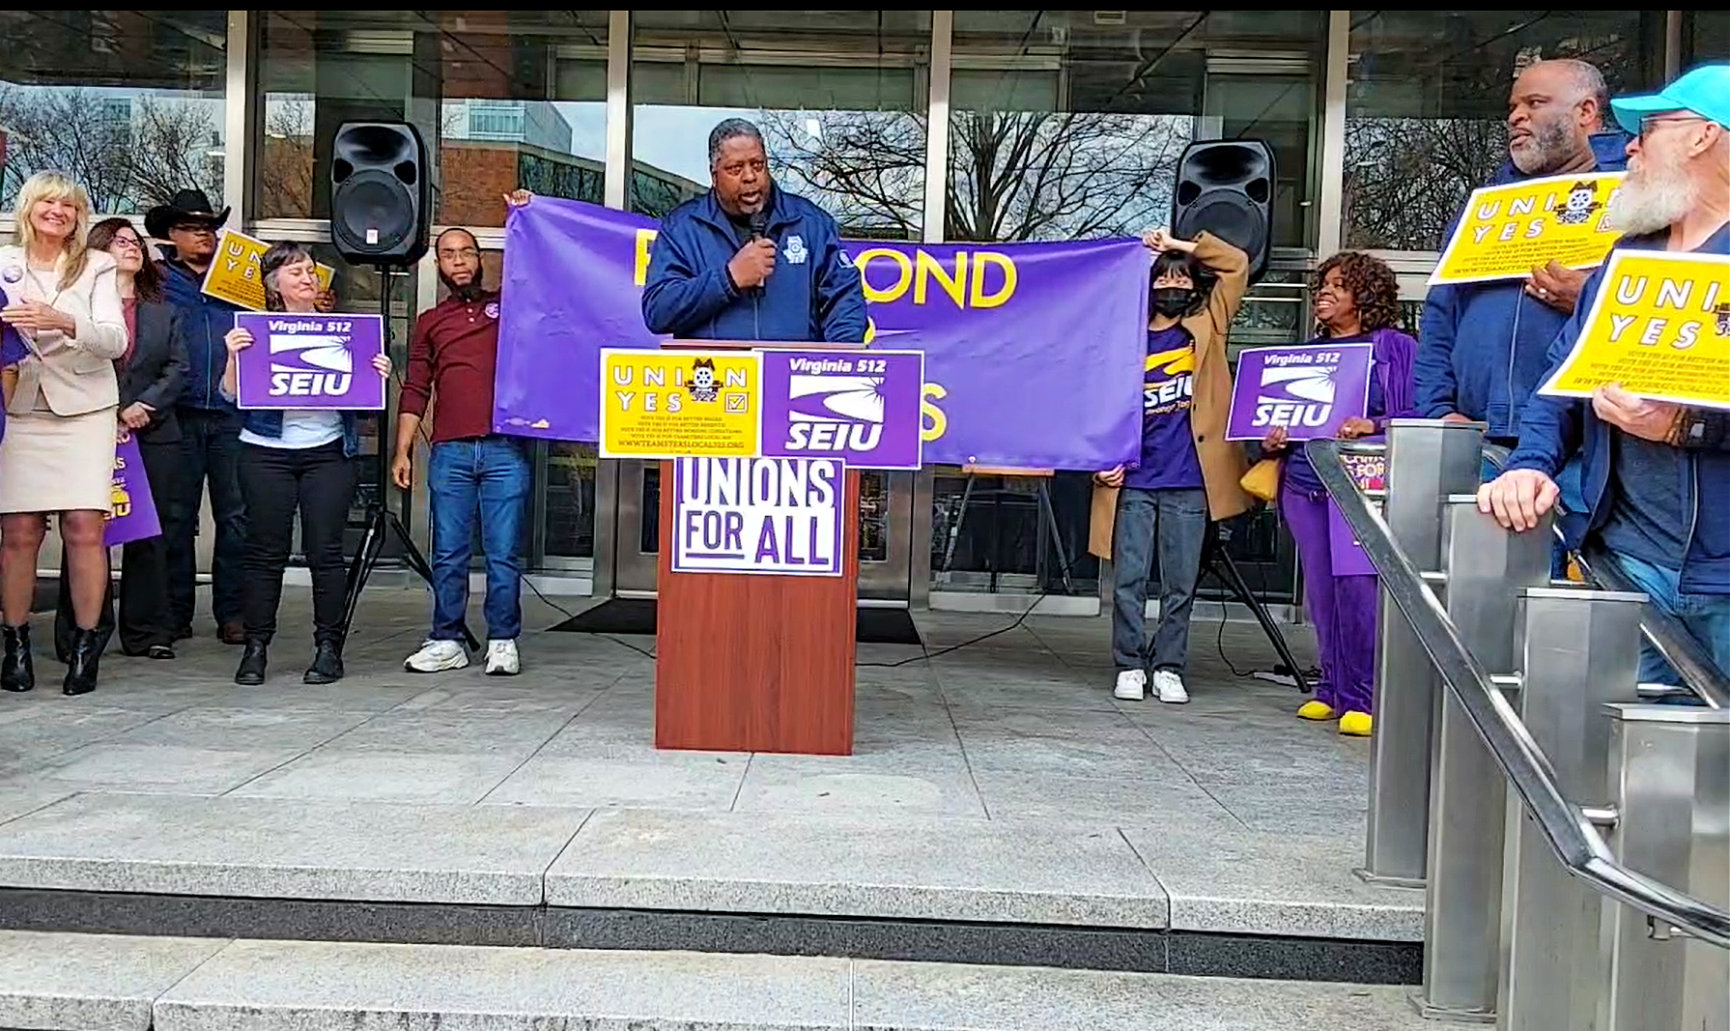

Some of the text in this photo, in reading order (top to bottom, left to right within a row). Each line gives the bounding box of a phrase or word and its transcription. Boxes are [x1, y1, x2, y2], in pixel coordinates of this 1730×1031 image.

[1473, 218, 1545, 244] YES
[224, 256, 256, 280] YE
[268, 320, 352, 334] Virginia 512
[1608, 313, 1703, 350] YES
[789, 358, 887, 375] Virginia 512
[1264, 352, 1341, 366] Virginia 512
[268, 373, 352, 396] SEIU
[616, 390, 683, 412] YES
[1251, 404, 1333, 427] SEIU
[785, 422, 884, 451] SEIU
[682, 457, 836, 507] UNIONS
[685, 510, 829, 565] FOR ALL
